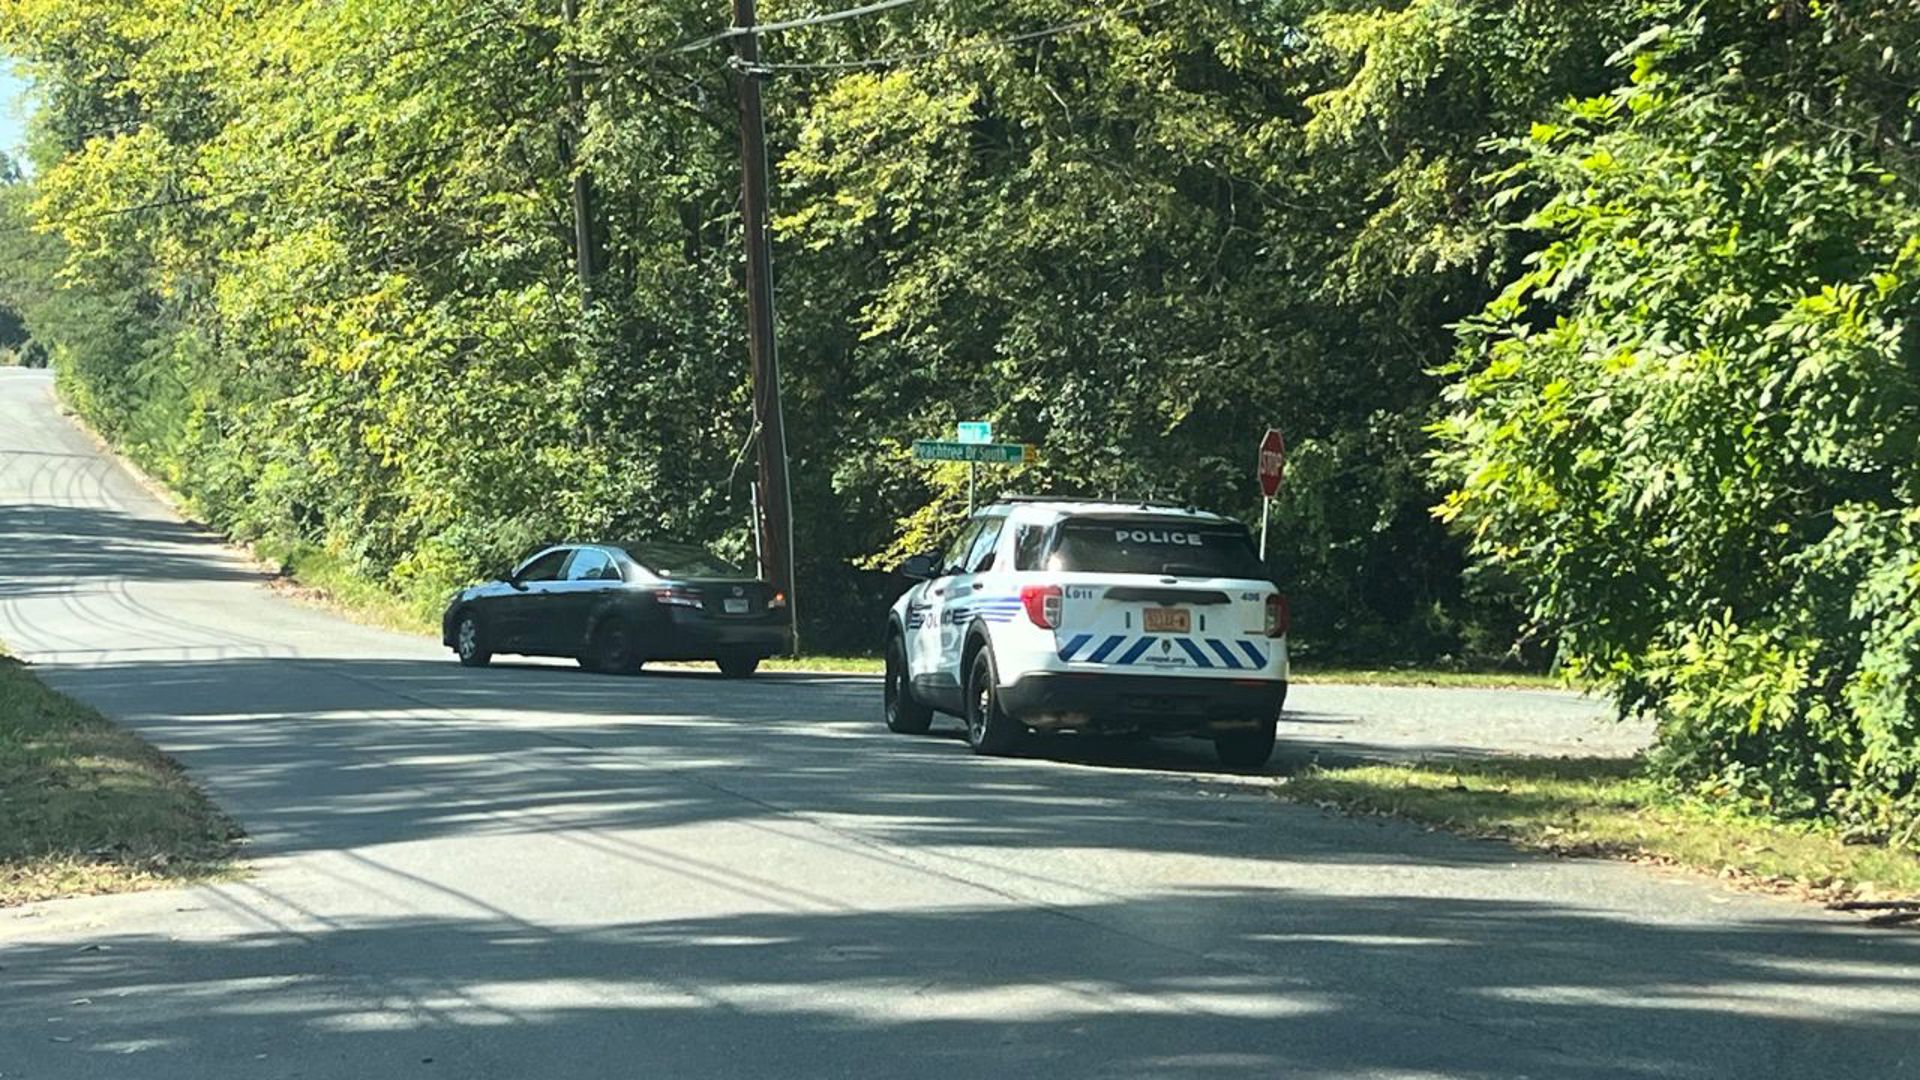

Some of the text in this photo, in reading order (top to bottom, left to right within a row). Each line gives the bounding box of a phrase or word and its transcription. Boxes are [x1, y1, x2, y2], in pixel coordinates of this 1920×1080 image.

[913, 442, 963, 459] Peachtree
[965, 444, 976, 459] Dr
[980, 445, 1007, 461] South
[1261, 452, 1282, 475] STOP
[1115, 530, 1203, 546] POLICE
